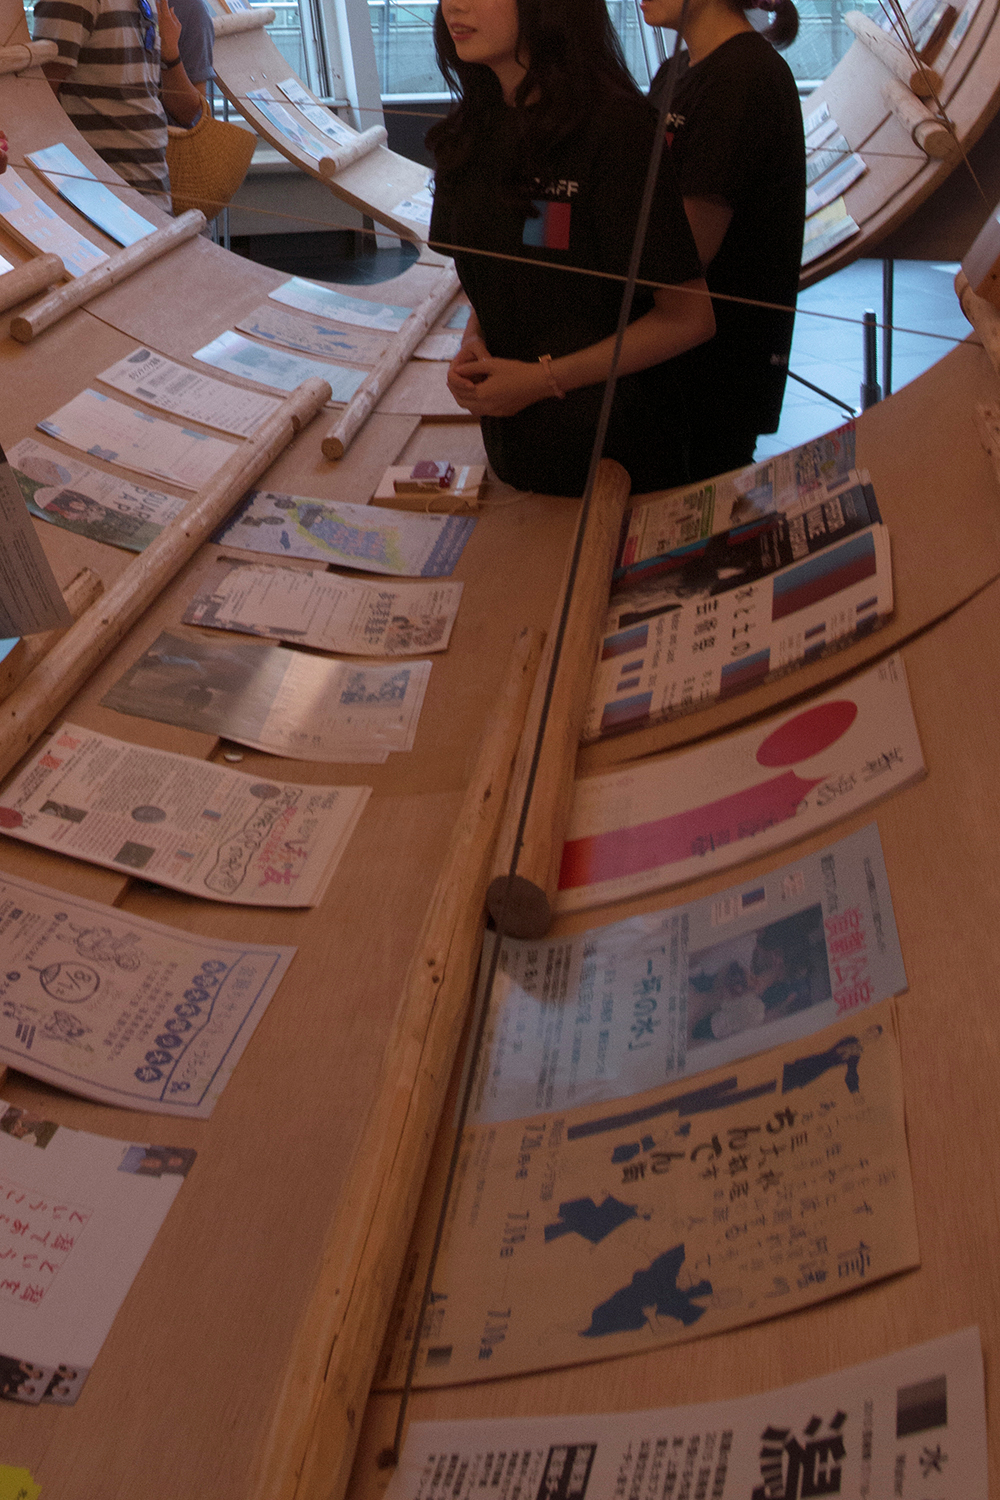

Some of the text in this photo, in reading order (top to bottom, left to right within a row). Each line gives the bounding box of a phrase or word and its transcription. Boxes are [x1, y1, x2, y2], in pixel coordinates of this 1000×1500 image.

[691, 597, 719, 655] 芸術祭
[730, 584, 758, 659] 水と土の
